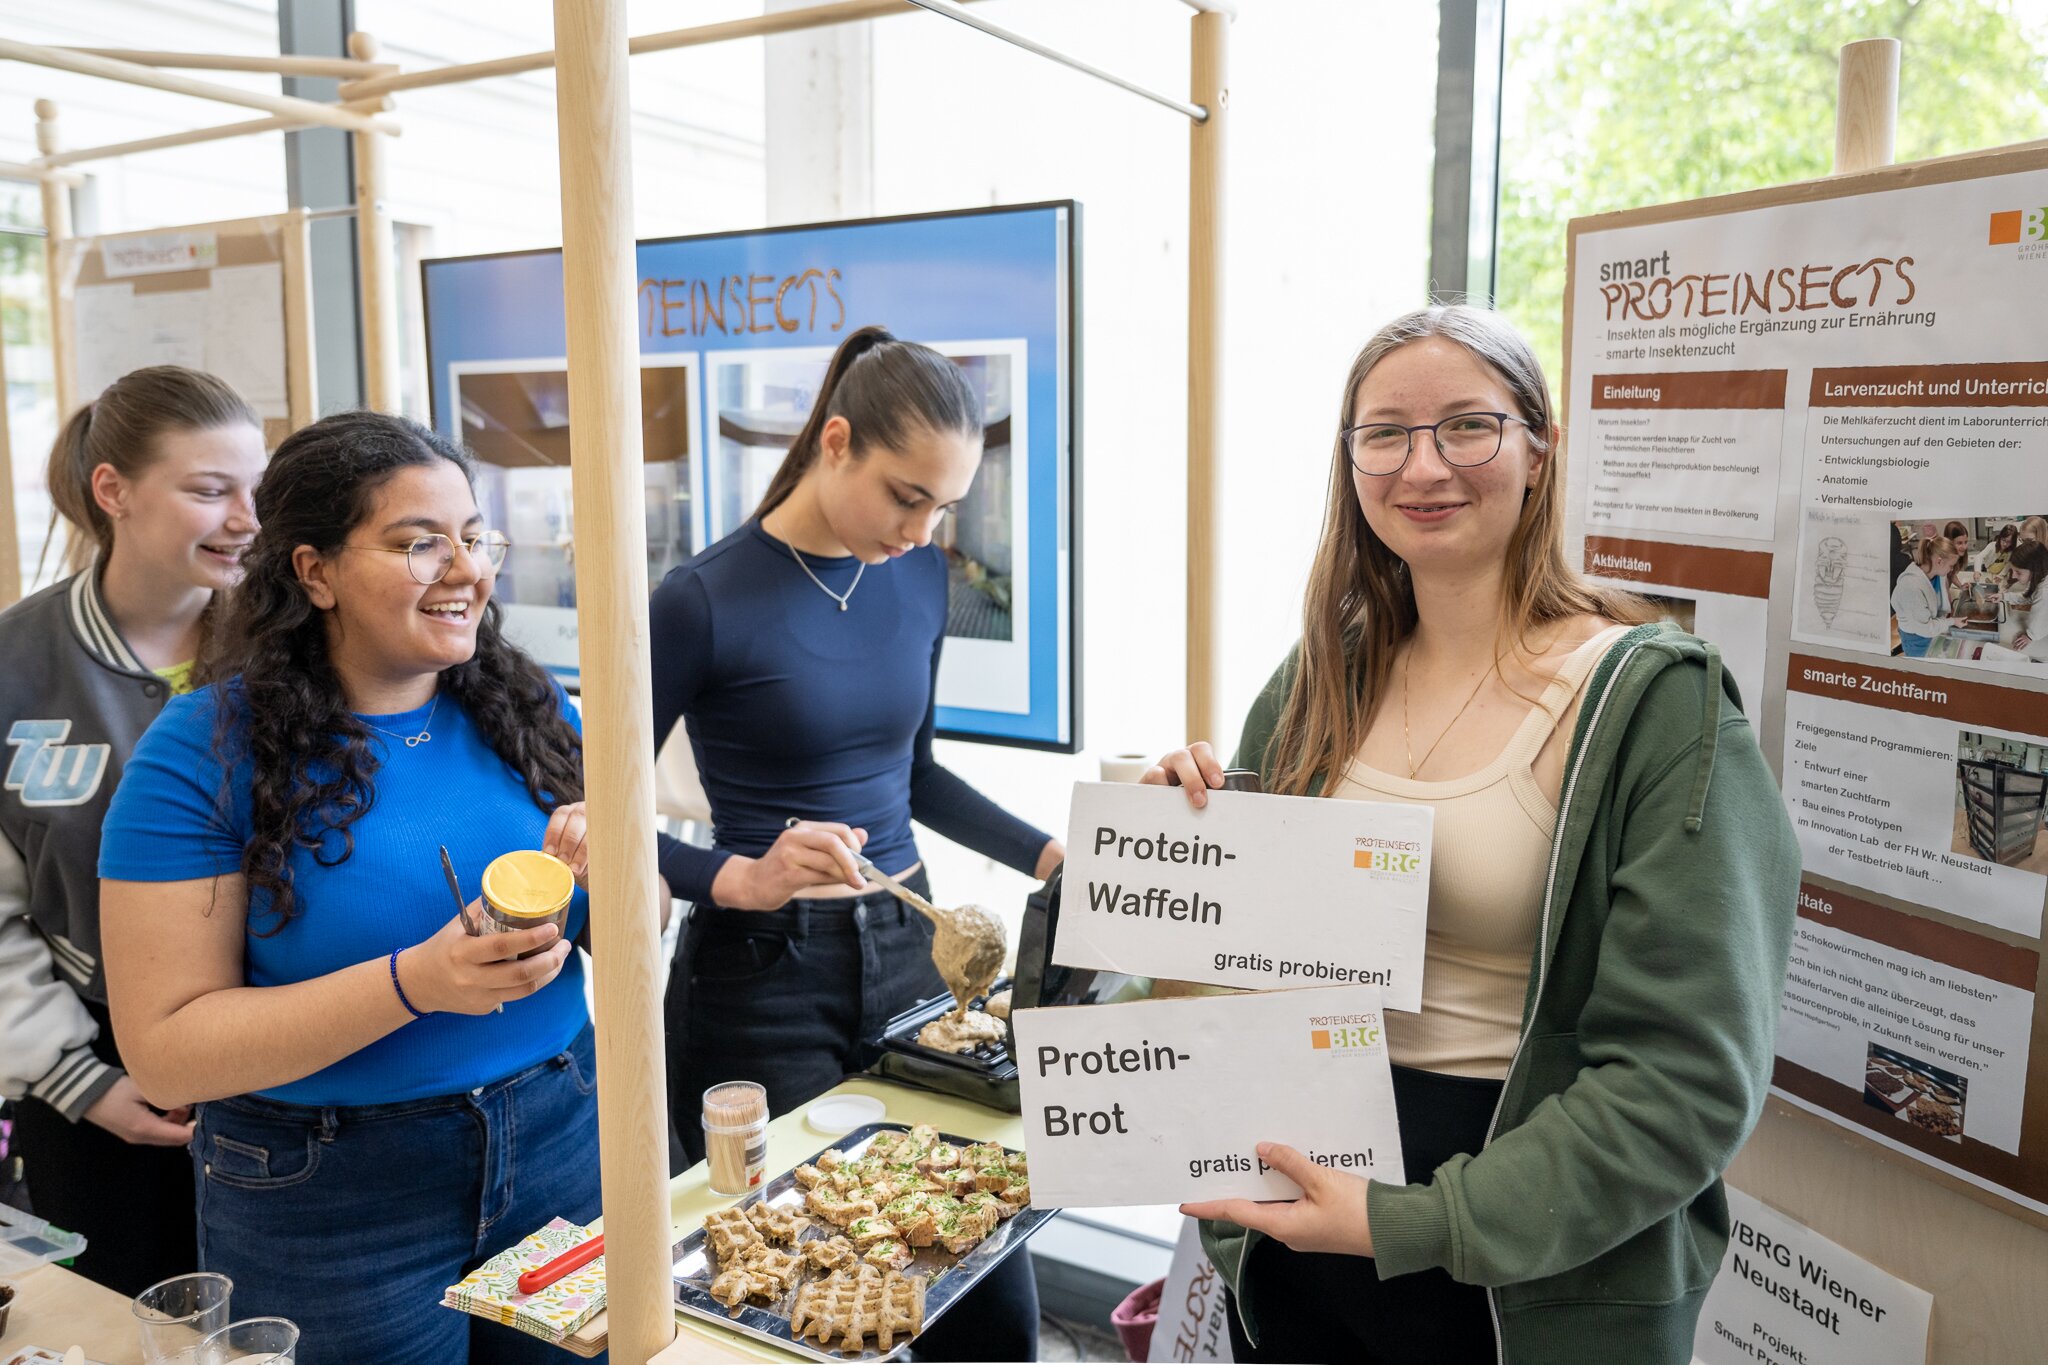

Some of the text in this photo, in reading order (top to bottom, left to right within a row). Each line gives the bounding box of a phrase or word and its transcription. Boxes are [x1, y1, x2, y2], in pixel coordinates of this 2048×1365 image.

[1600, 250, 1670, 281] smart
[1599, 256, 1915, 321] PROTEINSECTS
[1607, 310, 1936, 341] Insekten als mögliche Ergänzung zur Ernährung
[1606, 342, 1736, 360] smarte Insektenzucht
[1603, 385, 1661, 401] Einleitung
[1824, 379, 1924, 397] Larvenzucht
[1928, 379, 1960, 396] und
[1823, 416, 1839, 425] Die
[1841, 416, 1917, 427] Mehlkäferzucht
[1918, 416, 1946, 427] dient
[1948, 416, 1960, 426] im
[1642, 435, 1667, 443] werden
[1668, 435, 1689, 444] knapp
[1701, 436, 1722, 444] Zucht
[1820, 435, 2022, 449] Untersuchungen auf den Gebieten der:
[1639, 461, 1650, 469] der
[1651, 461, 1712, 472] Fleischproduktion
[1712, 464, 1760, 475] beschleunigt
[1824, 455, 1930, 469] Entwicklungsbiologie
[1822, 475, 1869, 486] Anatomie
[1673, 505, 1703, 515] Insekten
[1704, 507, 1711, 515] in
[1712, 508, 1759, 520] Bevölkerung
[1820, 494, 1913, 509] Verhaltensbiologie
[1592, 553, 1652, 573] Aktivitäten
[1803, 668, 1948, 704] smarte Zuchtfarm
[1794, 739, 1817, 752] Ziele
[1796, 721, 1954, 762] Freigegenstand Programmieren:
[1804, 759, 1868, 782] Entwurf einer
[1801, 779, 1891, 808] smarten Zuchtfarm
[1802, 798, 1903, 833] Bau eines Prototypen
[1093, 826, 1237, 867] Protein-
[1797, 816, 1993, 876] im Innovation Lab der FH Wr. Neustadt
[1373, 851, 1421, 873] BRG
[1828, 844, 1846, 857] der
[1847, 848, 1904, 872] Testbetrieb
[1905, 865, 1930, 881] läuft
[1087, 880, 1222, 926] Waffeln
[1797, 891, 1833, 915] itate
[1213, 951, 1392, 987] gratis probieren!
[1800, 930, 1884, 967] Schokowürmchen
[1886, 959, 1908, 977] mag
[1910, 967, 1927, 980] ich
[1929, 974, 1946, 987] am
[1807, 960, 1821, 974] bin
[1823, 964, 1838, 979] ich
[1839, 971, 1863, 988] nicht
[1864, 982, 1889, 999] ganz
[1890, 991, 1947, 1020] überzeugt,
[1950, 1012, 1976, 1029] dass
[1332, 1027, 1380, 1048] BRG
[1850, 995, 1866, 1008] die
[1867, 1002, 1910, 1025] alleinige
[1912, 1017, 1951, 1041] Lösung
[1953, 1033, 1970, 1047] für
[1972, 1043, 2006, 1058] unser
[1862, 1018, 1872, 1029] in
[1872, 1022, 1913, 1045] Zukunft
[1914, 1039, 1936, 1054] sein
[1036, 1039, 1191, 1078] Protein-
[1043, 1102, 1129, 1137] Brot
[1188, 1153, 1252, 1178] gratis
[1732, 1252, 1841, 1336] Neustadt
[1798, 1254, 1888, 1323] Wiener
[1714, 1320, 1754, 1357] Smart
